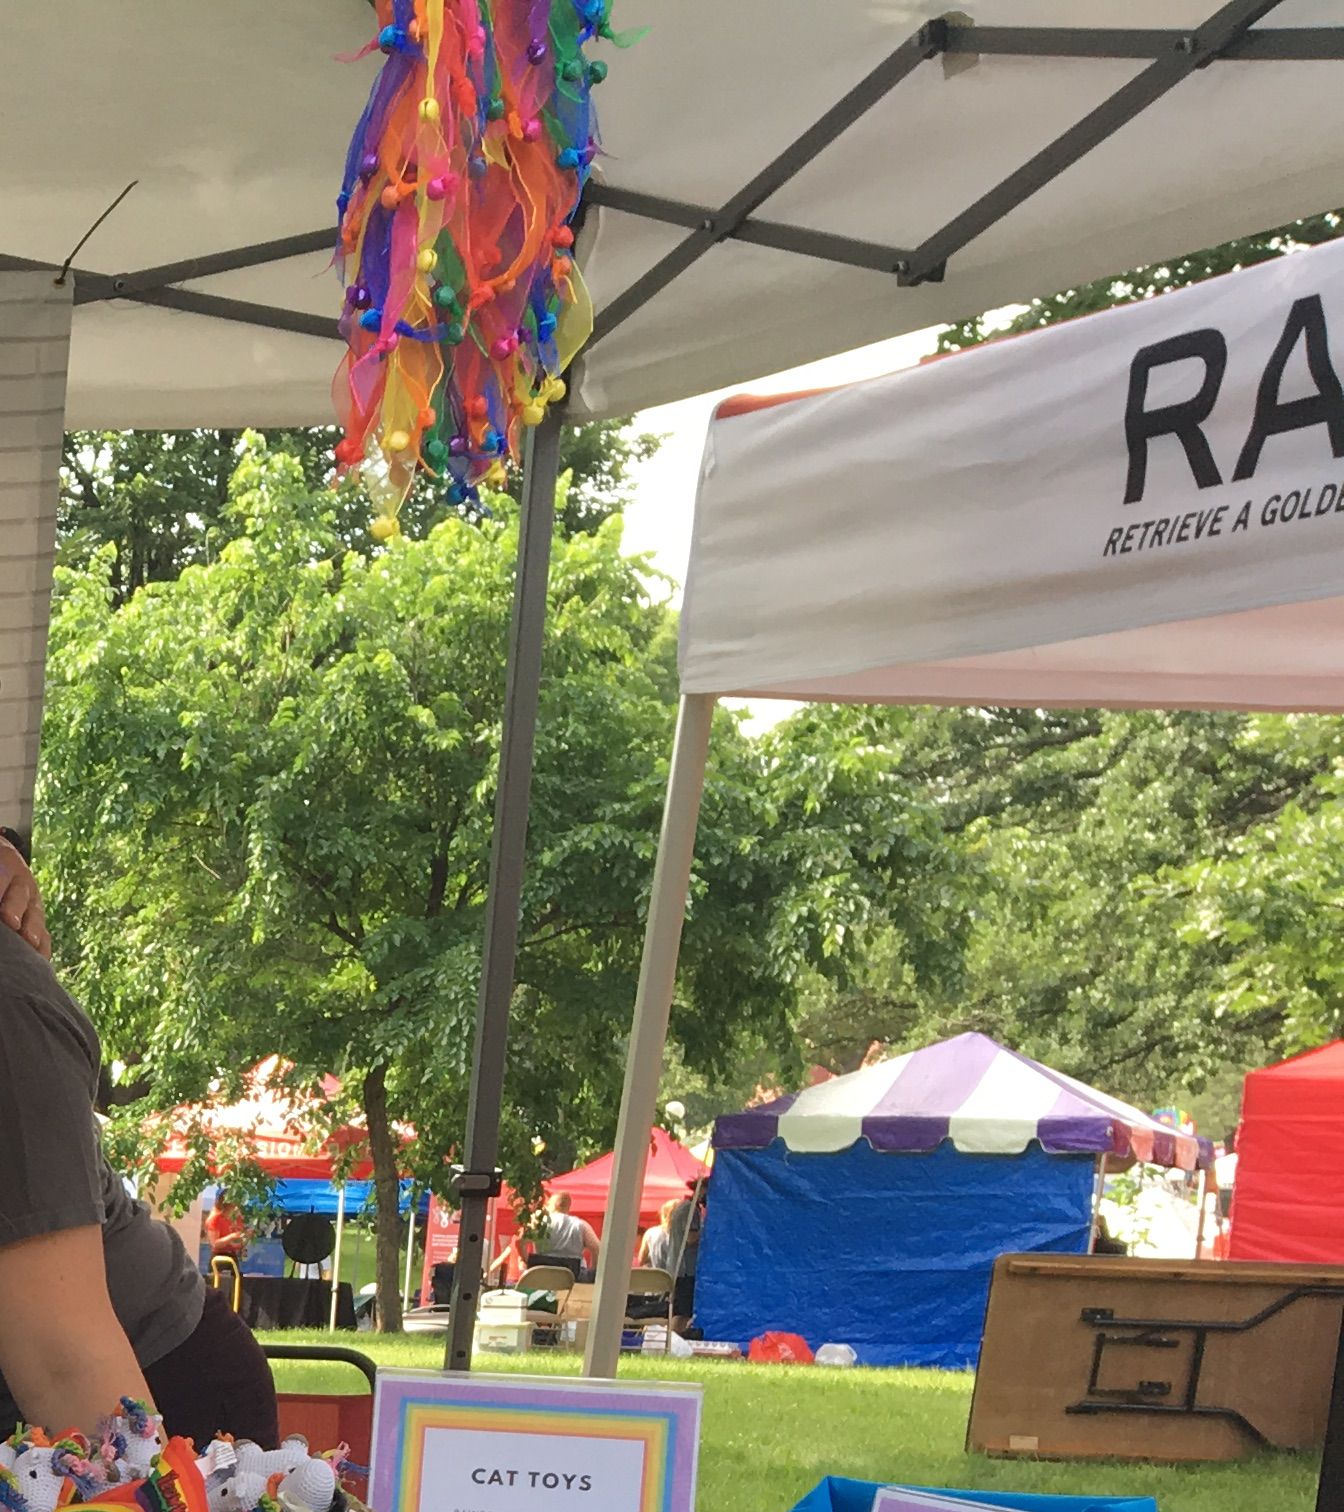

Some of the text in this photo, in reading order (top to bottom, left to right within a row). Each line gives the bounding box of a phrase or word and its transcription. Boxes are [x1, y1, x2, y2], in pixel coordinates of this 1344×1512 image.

[1103, 505, 1230, 557] RETRIEVE
[1231, 500, 1253, 532] A
[471, 1468, 592, 1491] CAT TOYS
